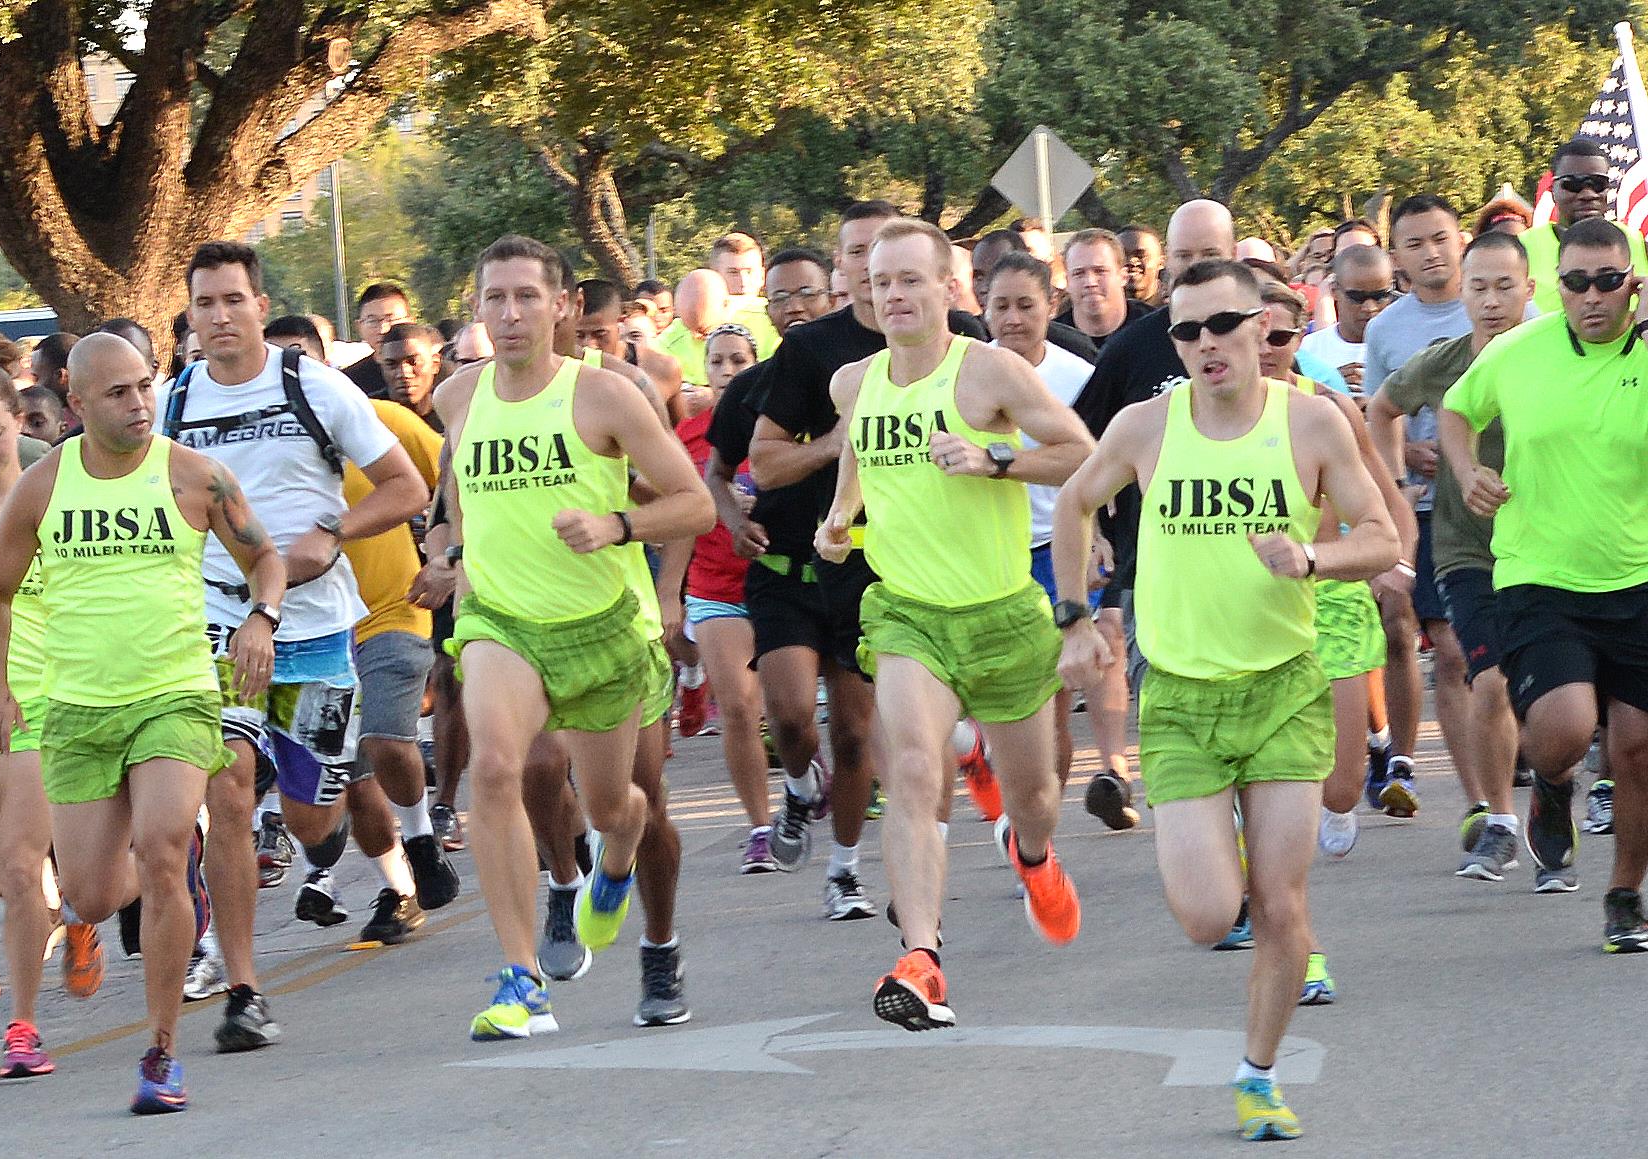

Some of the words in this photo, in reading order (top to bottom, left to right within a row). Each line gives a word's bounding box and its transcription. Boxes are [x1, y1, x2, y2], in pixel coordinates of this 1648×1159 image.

[856, 410, 950, 452] JBSA
[465, 433, 574, 477] JBSA
[870, 453, 914, 467] MILER
[466, 482, 479, 493] 10
[482, 478, 529, 492] MILER
[532, 473, 576, 487] TEAM
[1159, 477, 1290, 518] JBSA
[53, 507, 175, 544] JBSA
[1161, 523, 1176, 535] 10
[1182, 523, 1236, 535] MILER
[1243, 522, 1290, 535] TEAM
[54, 548, 68, 558] 10
[73, 545, 124, 558] MILER
[129, 544, 175, 555] TEAM
